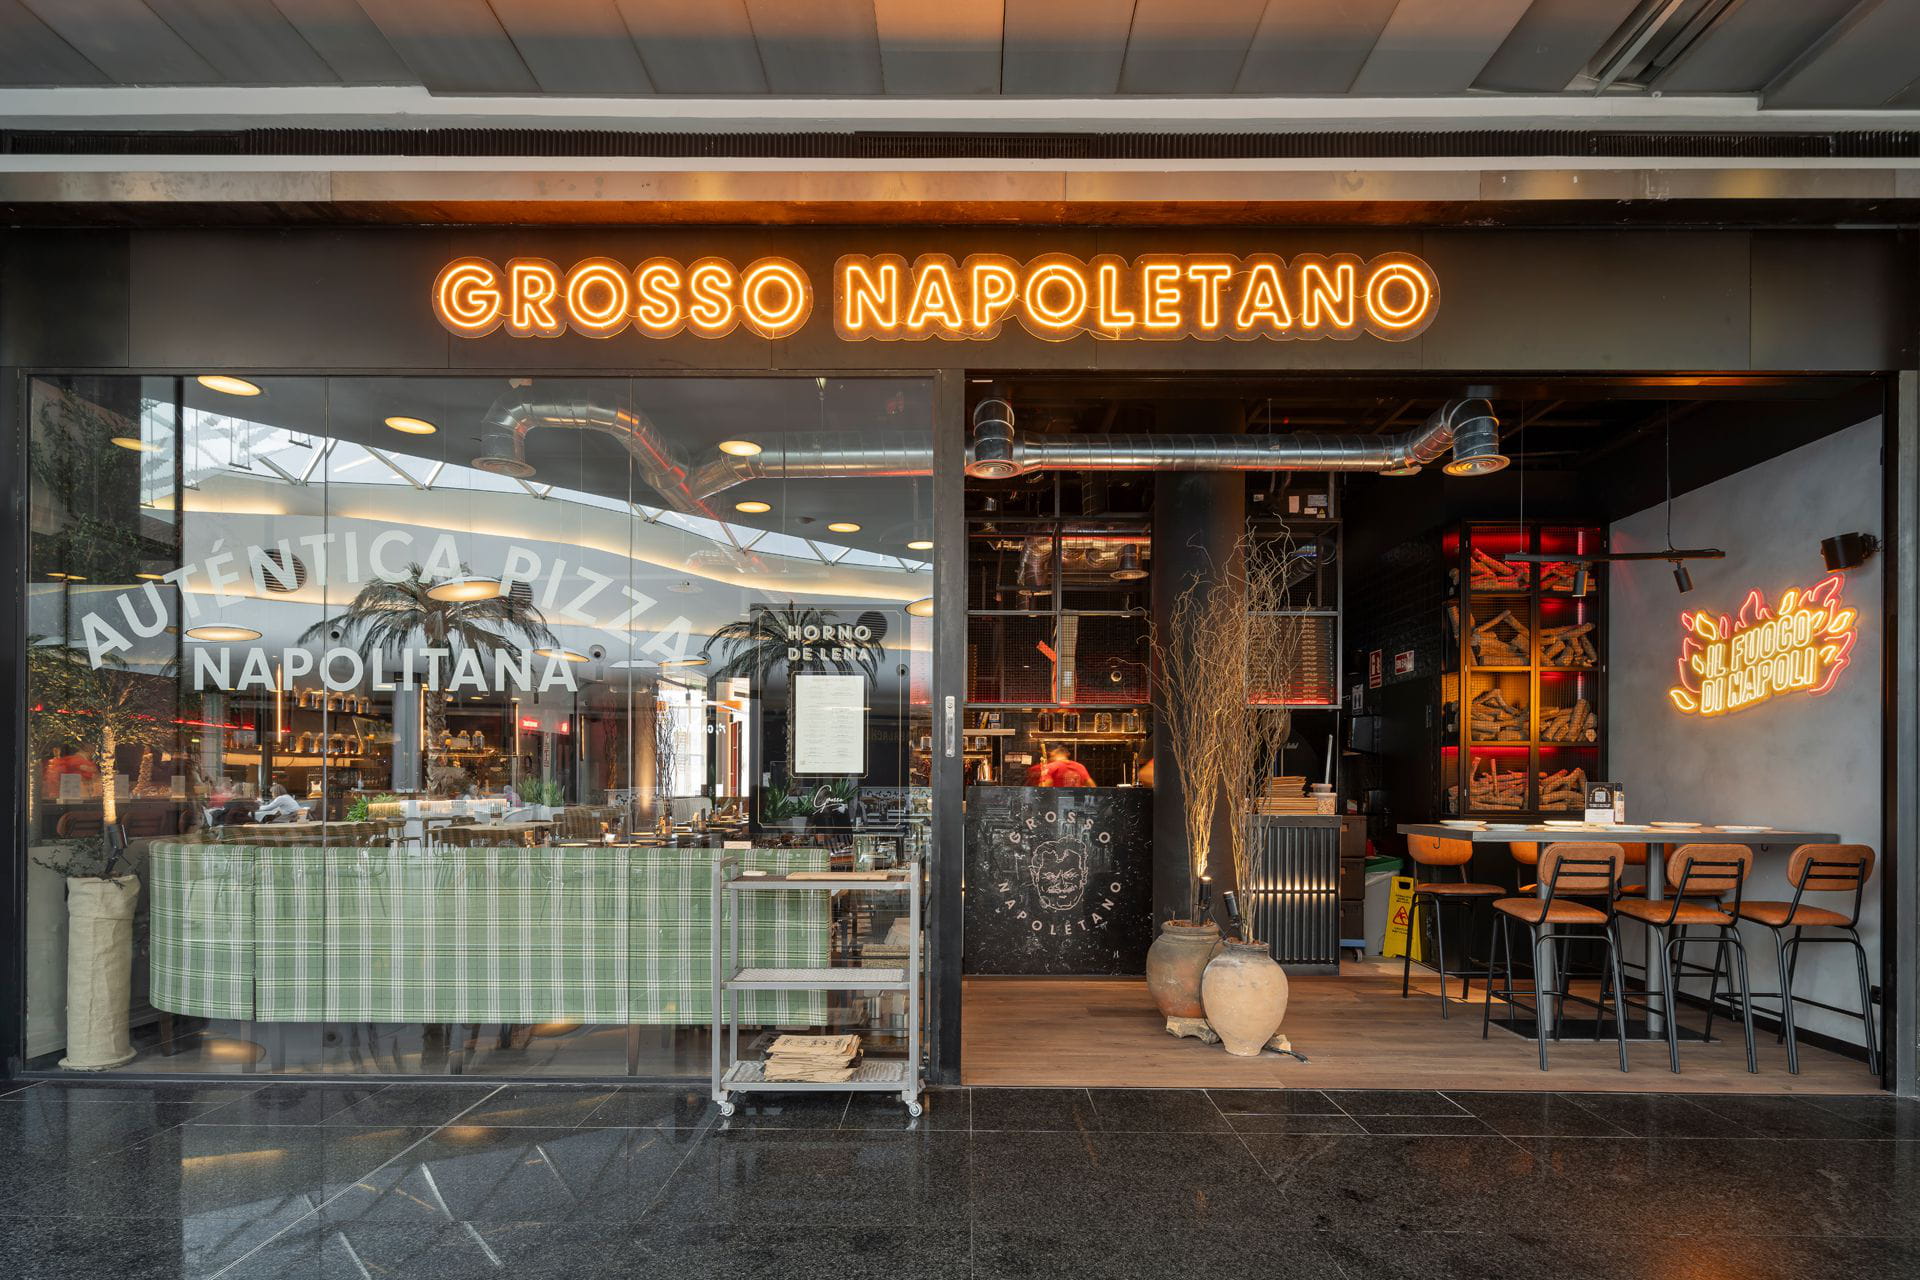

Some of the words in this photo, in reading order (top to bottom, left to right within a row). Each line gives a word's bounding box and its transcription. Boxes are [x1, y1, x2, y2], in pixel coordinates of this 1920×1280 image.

[440, 265, 805, 328] GROSSO
[844, 263, 1430, 329] NAPOLETANO
[80, 529, 467, 671] AUTÉNTICA
[498, 545, 693, 676] PIZZA
[787, 624, 872, 641] HORNO
[787, 647, 813, 661] DE
[1706, 642, 1729, 678] IL
[1731, 609, 1813, 672] FUOCO
[193, 646, 579, 693] NAPOLITANA
[1701, 679, 1726, 713] DI
[1727, 647, 1818, 708] NAPOLI
[1008, 810, 1111, 845] GROSSO
[998, 881, 1122, 936] NAPOLETANO
